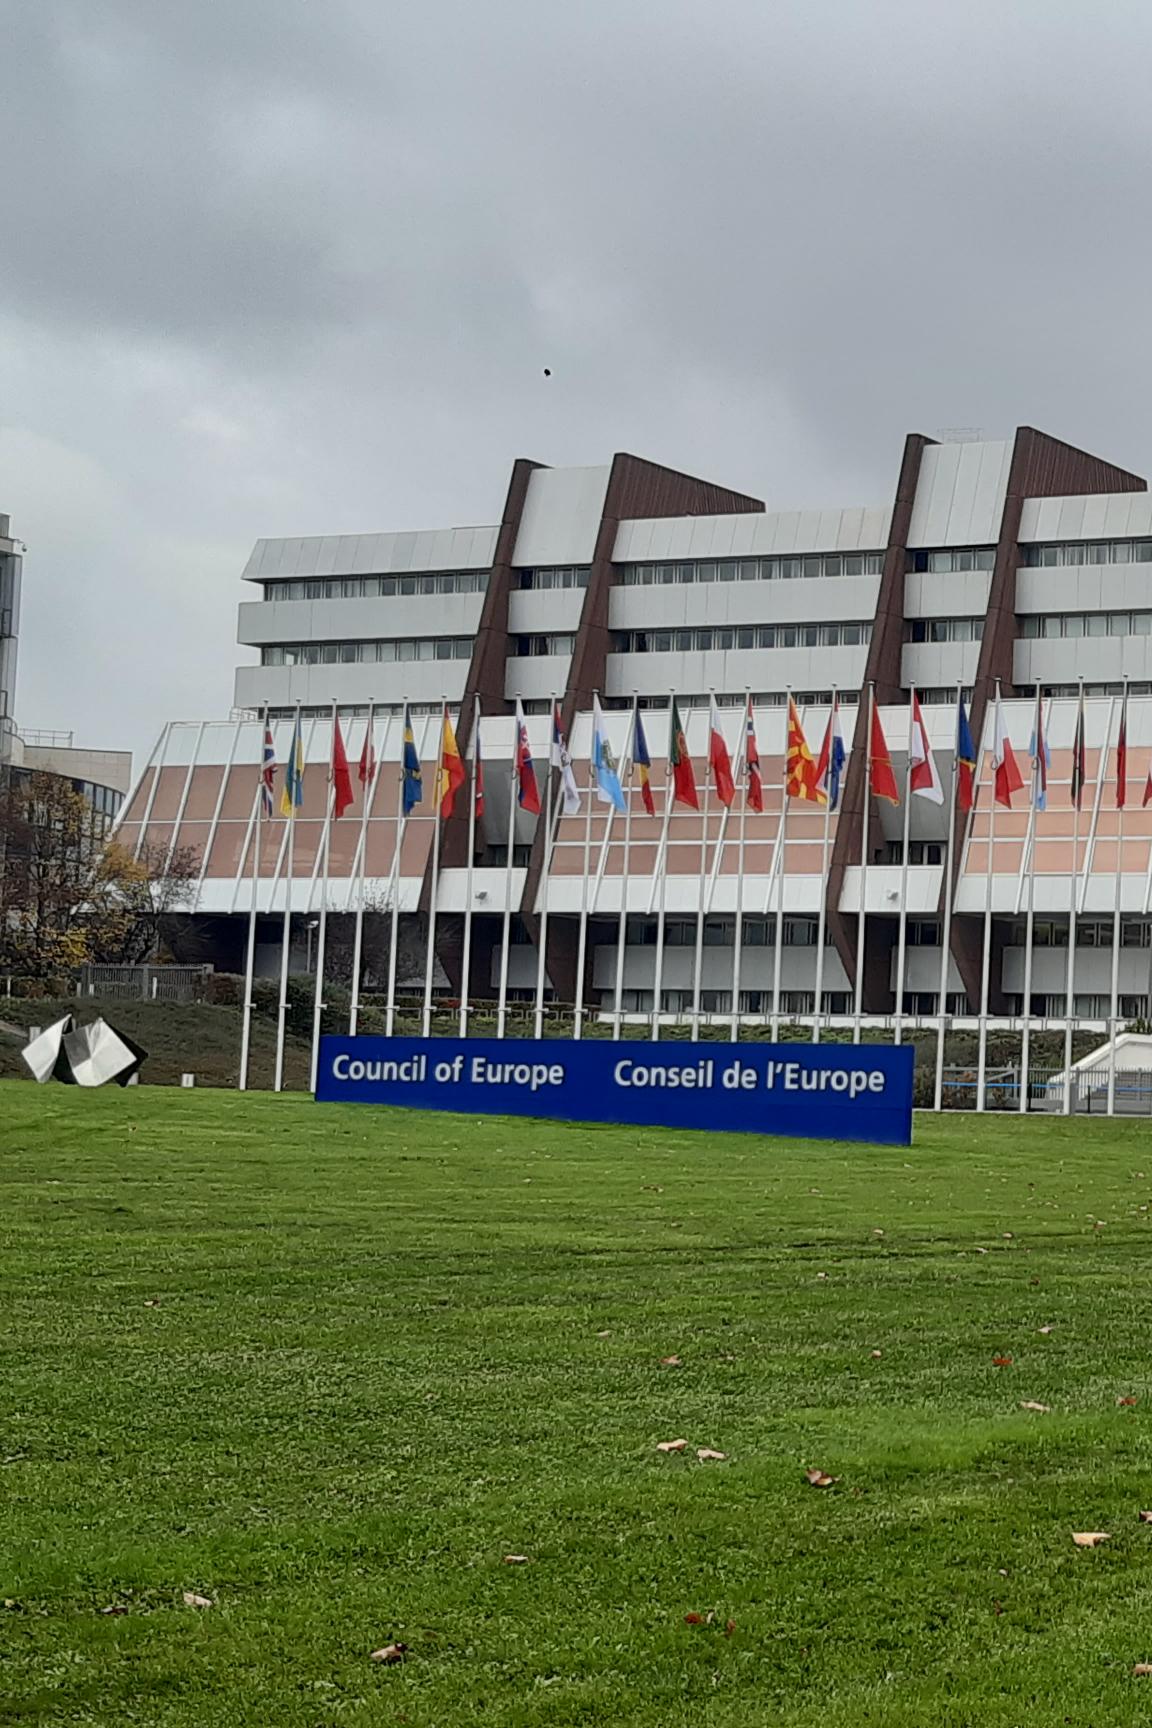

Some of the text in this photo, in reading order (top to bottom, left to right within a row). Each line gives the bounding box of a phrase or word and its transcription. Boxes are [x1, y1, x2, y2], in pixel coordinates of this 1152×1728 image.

[331, 1054, 565, 1092] Council of Europe
[613, 1059, 886, 1099] Conseil de l'Europe
